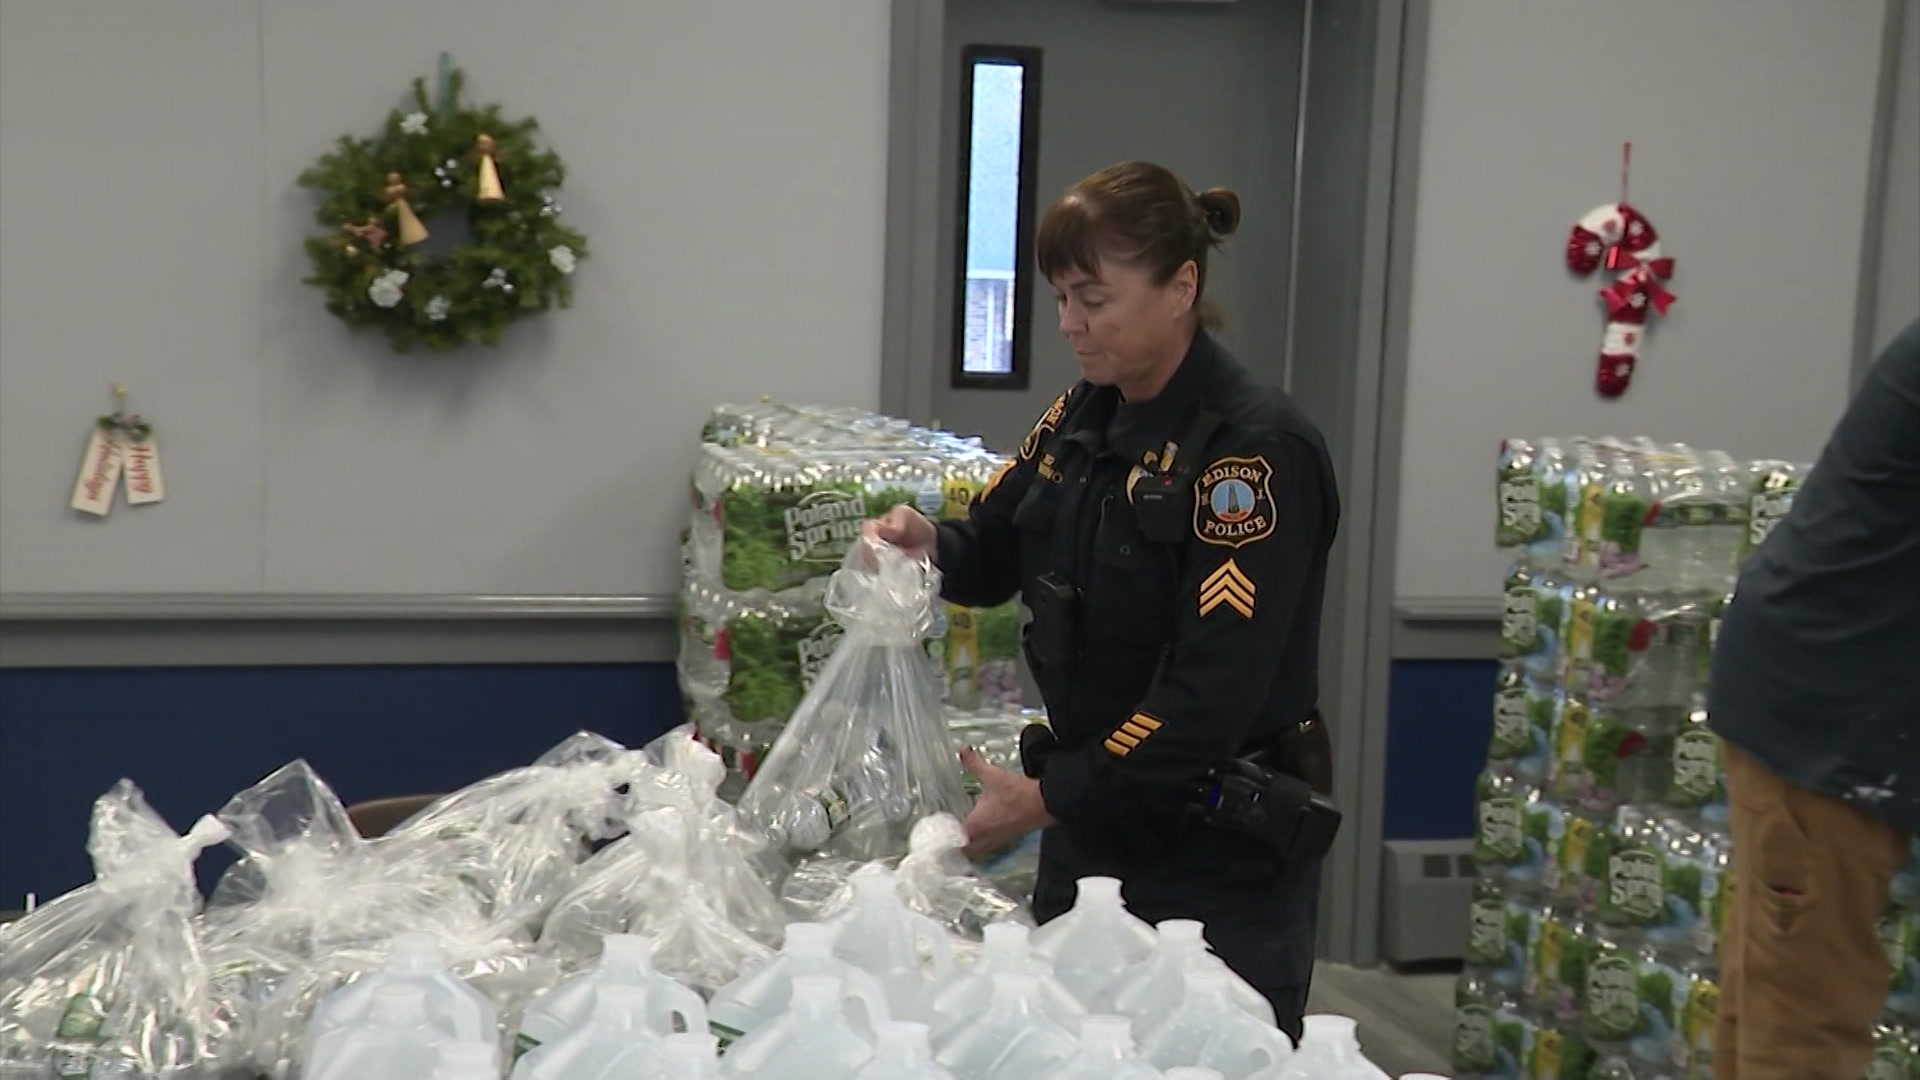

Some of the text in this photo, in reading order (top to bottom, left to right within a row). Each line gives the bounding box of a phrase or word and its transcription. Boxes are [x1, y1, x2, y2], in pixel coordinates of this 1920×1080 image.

[1201, 465, 1263, 487] EDISON
[784, 491, 866, 534] Poland
[1203, 515, 1267, 536] POLICE
